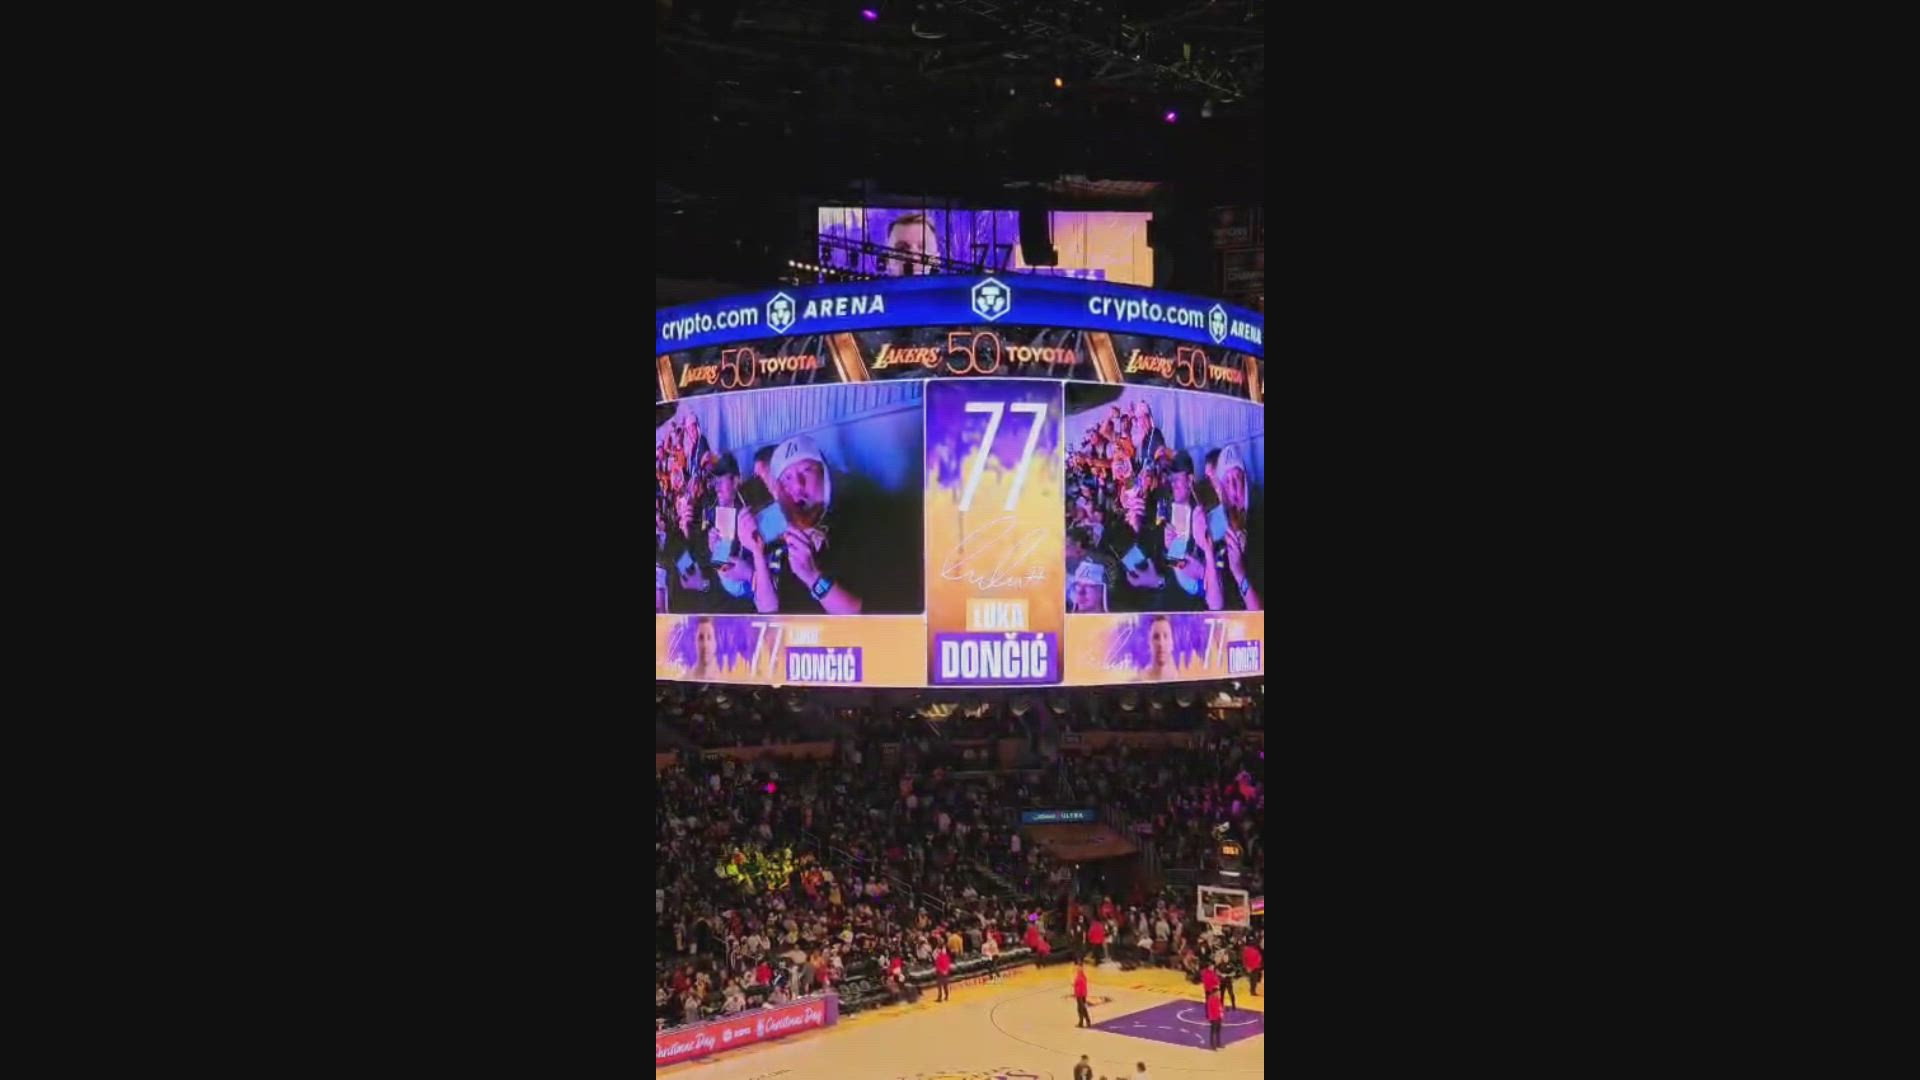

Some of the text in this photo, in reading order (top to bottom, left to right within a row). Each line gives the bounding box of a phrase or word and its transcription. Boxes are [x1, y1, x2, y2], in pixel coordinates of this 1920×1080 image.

[662, 295, 884, 340] crypto.com ARENA
[1088, 296, 1261, 344] crypto.com ARENA
[720, 347, 755, 388] 50
[759, 355, 817, 374] TOYOTA
[946, 331, 1000, 374] 50
[1005, 346, 1076, 364] TOYOTA
[1176, 346, 1206, 388] 50
[1208, 364, 1243, 384] TOYOTA
[959, 402, 1048, 511] 77
[973, 603, 1024, 630] LUKA
[752, 622, 783, 676] 77
[789, 648, 856, 681] DONČIĆ
[941, 632, 1048, 679] DONČIĆ
